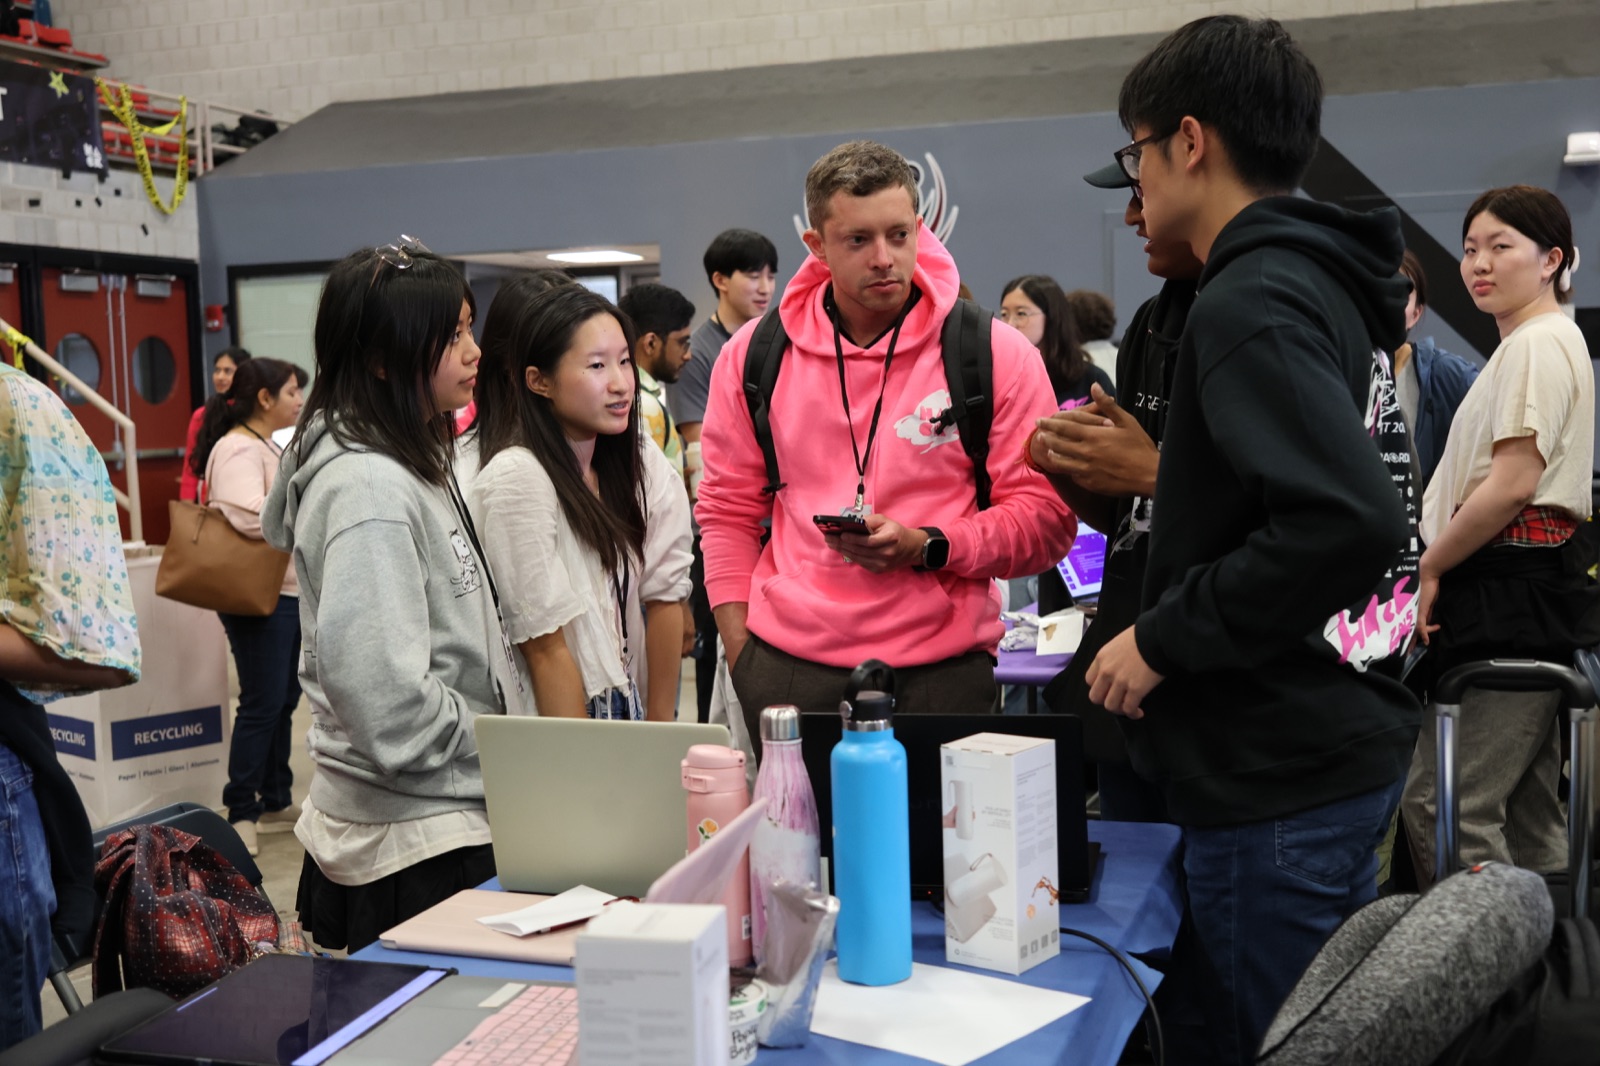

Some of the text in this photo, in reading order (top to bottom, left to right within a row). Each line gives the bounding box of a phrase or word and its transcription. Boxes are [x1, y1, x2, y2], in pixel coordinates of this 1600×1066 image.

[1391, 421, 1406, 433] 20
[134, 722, 203, 745] RECYCLING
[118, 772, 137, 782] Paper
